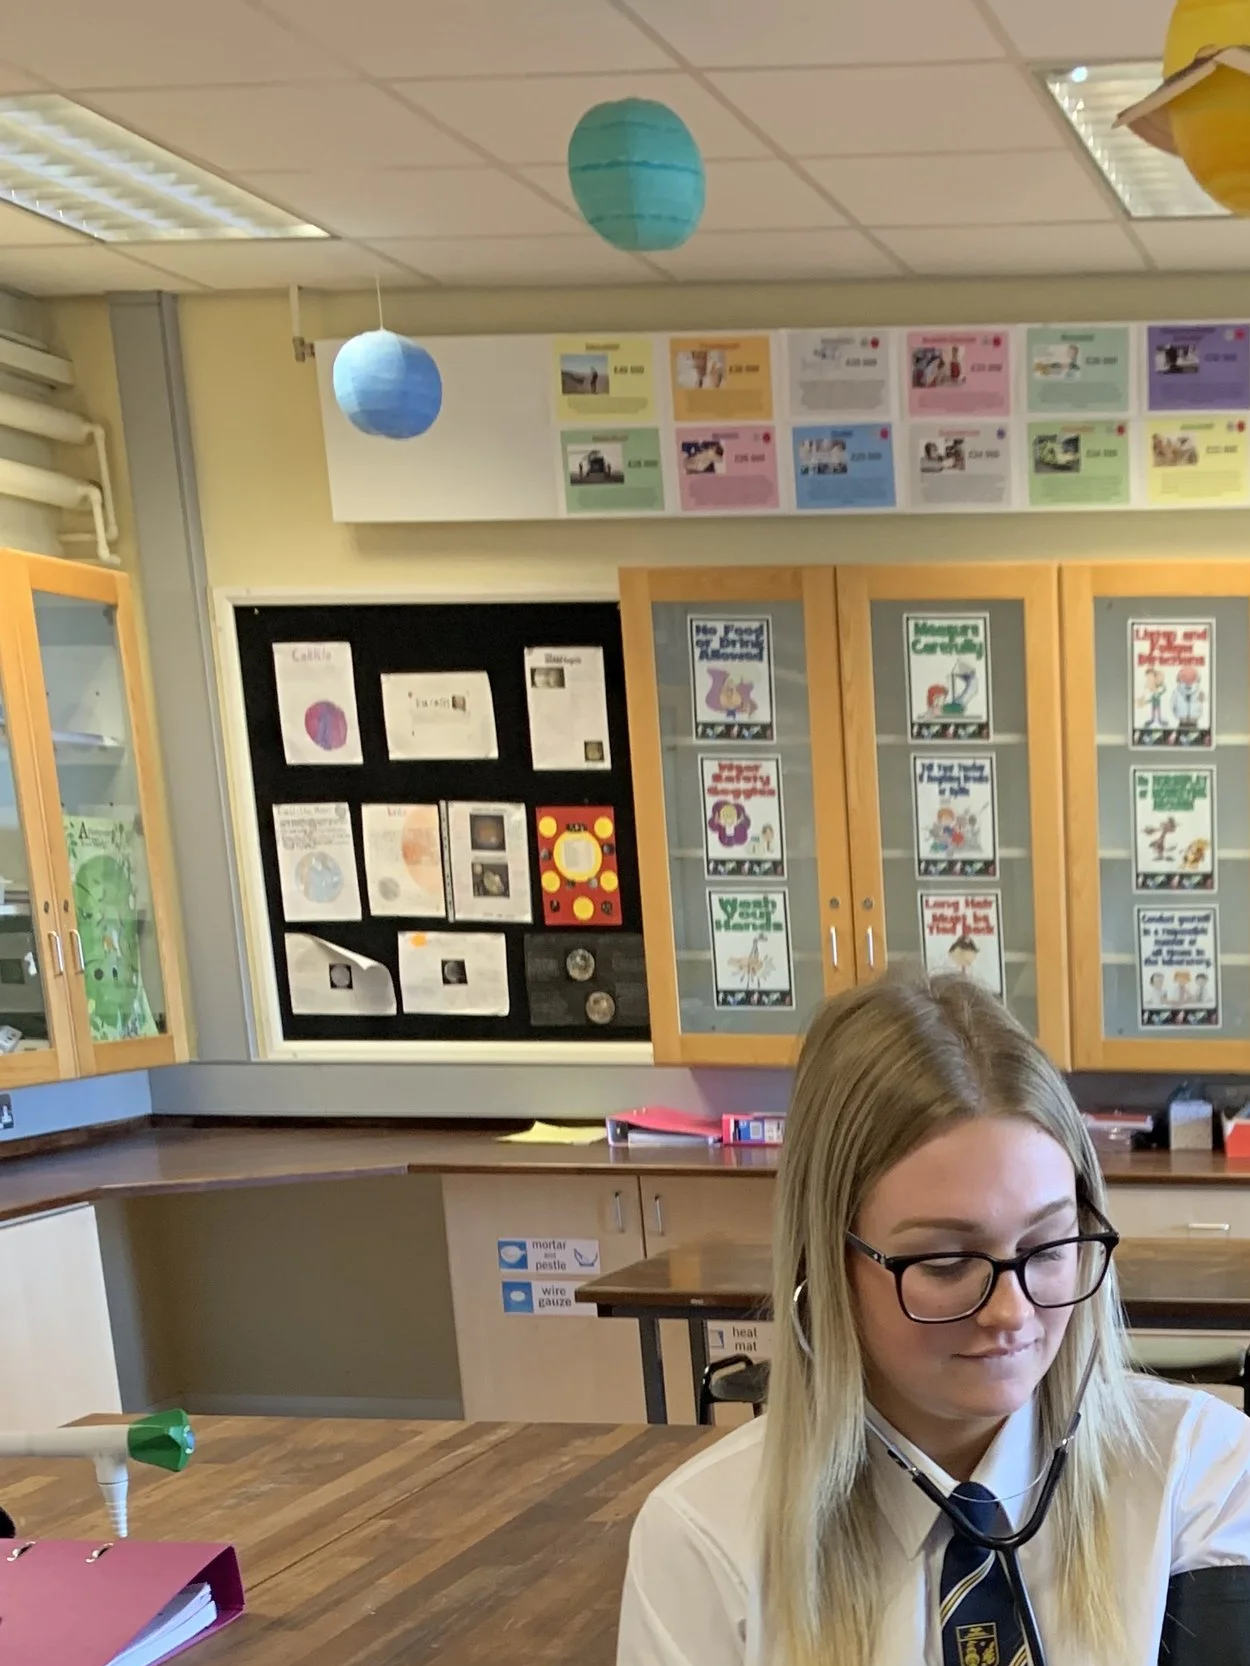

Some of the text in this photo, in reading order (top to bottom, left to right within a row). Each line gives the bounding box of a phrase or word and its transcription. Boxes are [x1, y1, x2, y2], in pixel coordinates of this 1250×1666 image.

[695, 624, 765, 638] No Food
[914, 621, 979, 637] Measure
[1183, 628, 1208, 641] and
[695, 637, 765, 650] or Drink
[911, 639, 984, 660] Carefully
[698, 649, 765, 662] Allowed
[711, 773, 771, 787] Safety
[706, 786, 776, 800] Goggles
[717, 896, 778, 911] Wash
[924, 897, 993, 913] Long Hair
[714, 919, 784, 932] Hands
[1141, 913, 1212, 928] Conduct yourself
[927, 924, 958, 936] Tied
[1161, 927, 1209, 938] responsible
[1144, 957, 1159, 967] the
[532, 1240, 566, 1251] mortar
[536, 1260, 567, 1273] pestle
[541, 1284, 567, 1297] wire
[538, 1297, 573, 1309] gauze
[731, 1325, 758, 1338] heat
[734, 1341, 758, 1352] mat
